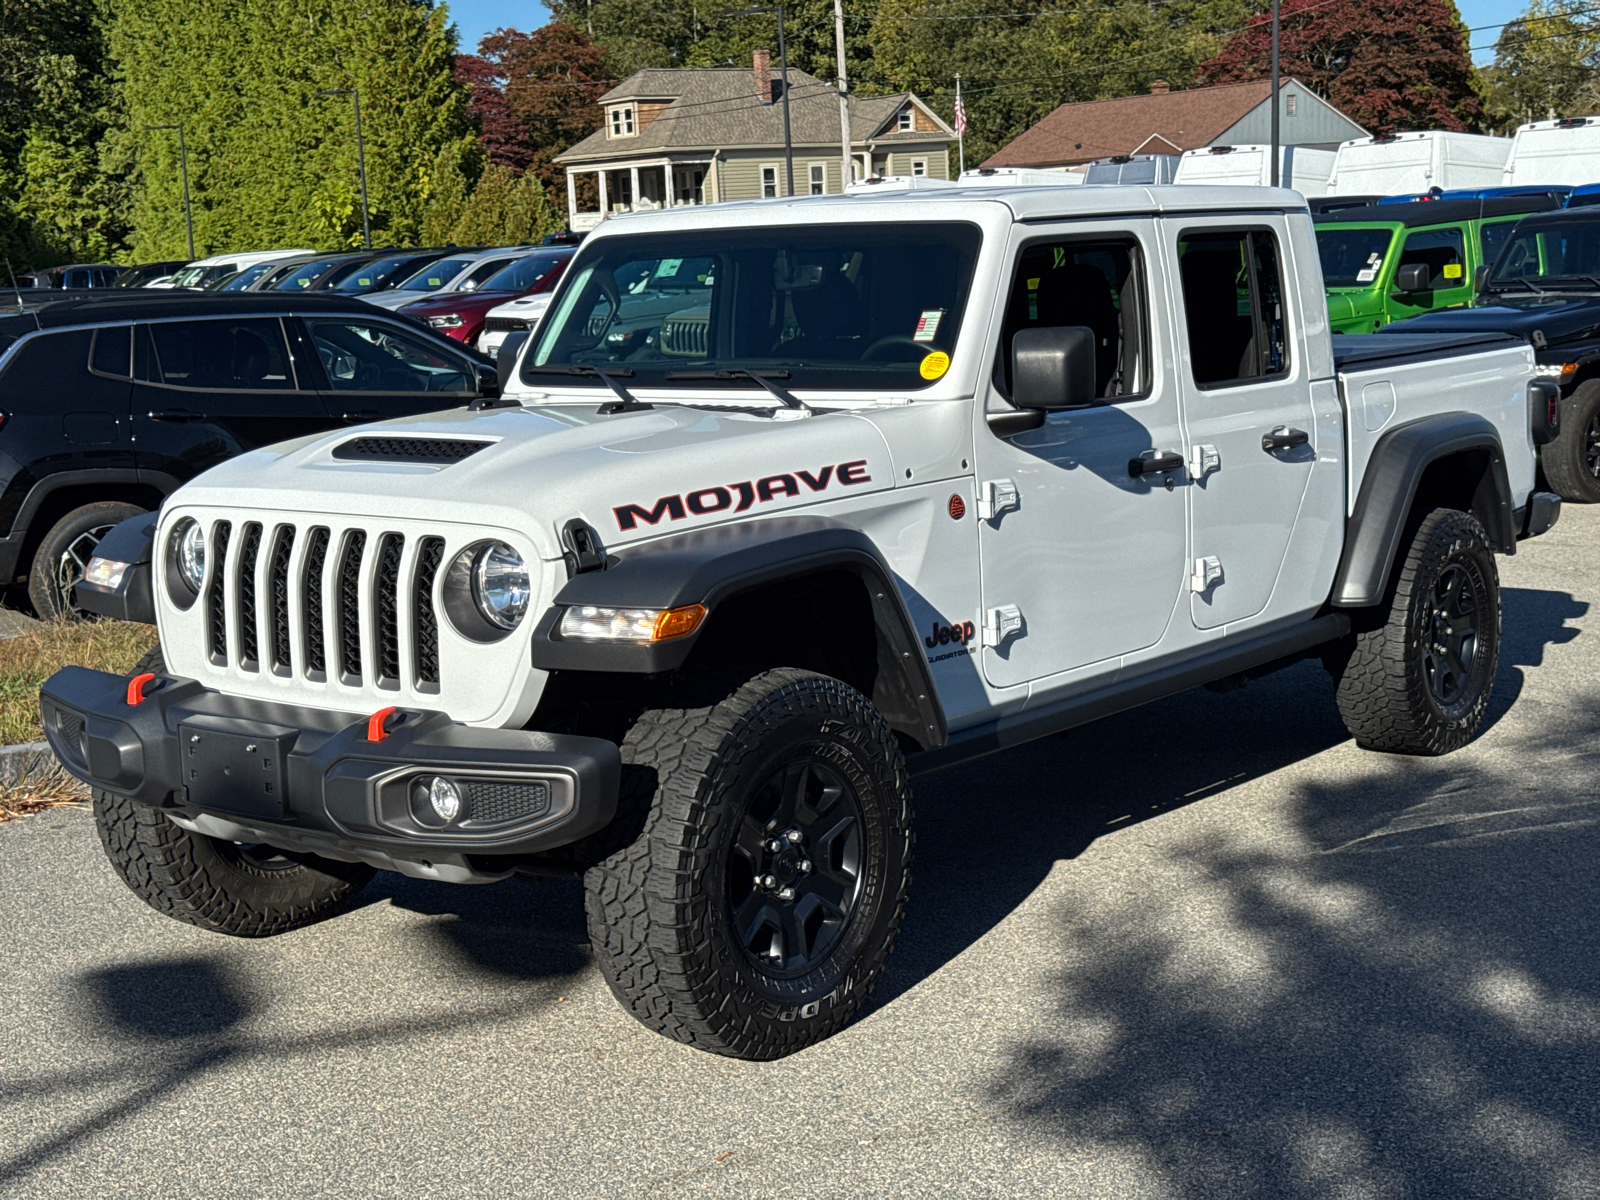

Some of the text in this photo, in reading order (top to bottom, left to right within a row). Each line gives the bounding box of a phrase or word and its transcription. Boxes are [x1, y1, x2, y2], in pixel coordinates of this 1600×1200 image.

[612, 459, 872, 532] MOJAVE
[925, 620, 976, 649] Jeep
[928, 648, 968, 664] GLADIATOR
